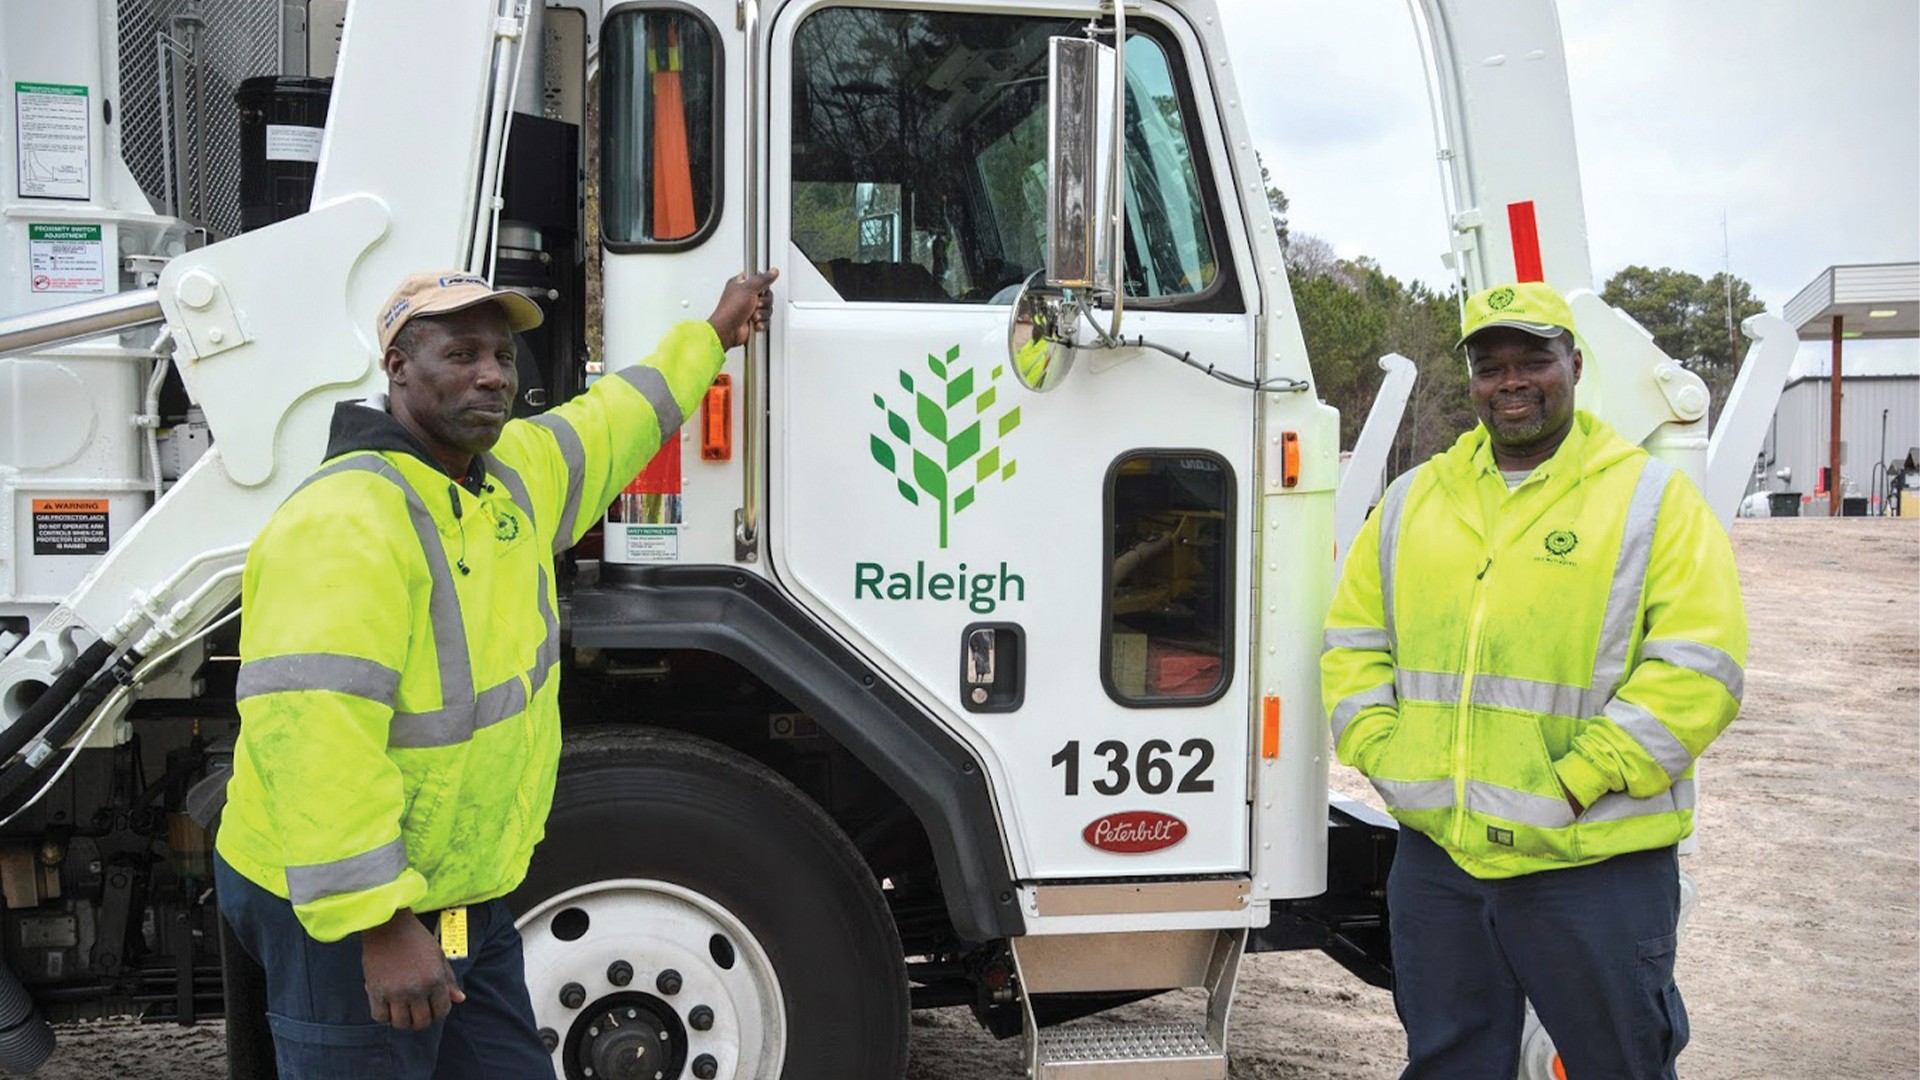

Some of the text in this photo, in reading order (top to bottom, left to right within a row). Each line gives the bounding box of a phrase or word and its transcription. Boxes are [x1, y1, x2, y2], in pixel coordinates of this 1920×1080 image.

[855, 561, 1025, 614] Raleigh
[1052, 738, 1214, 796] 1362
[1095, 819, 1179, 845] Peterbilt
